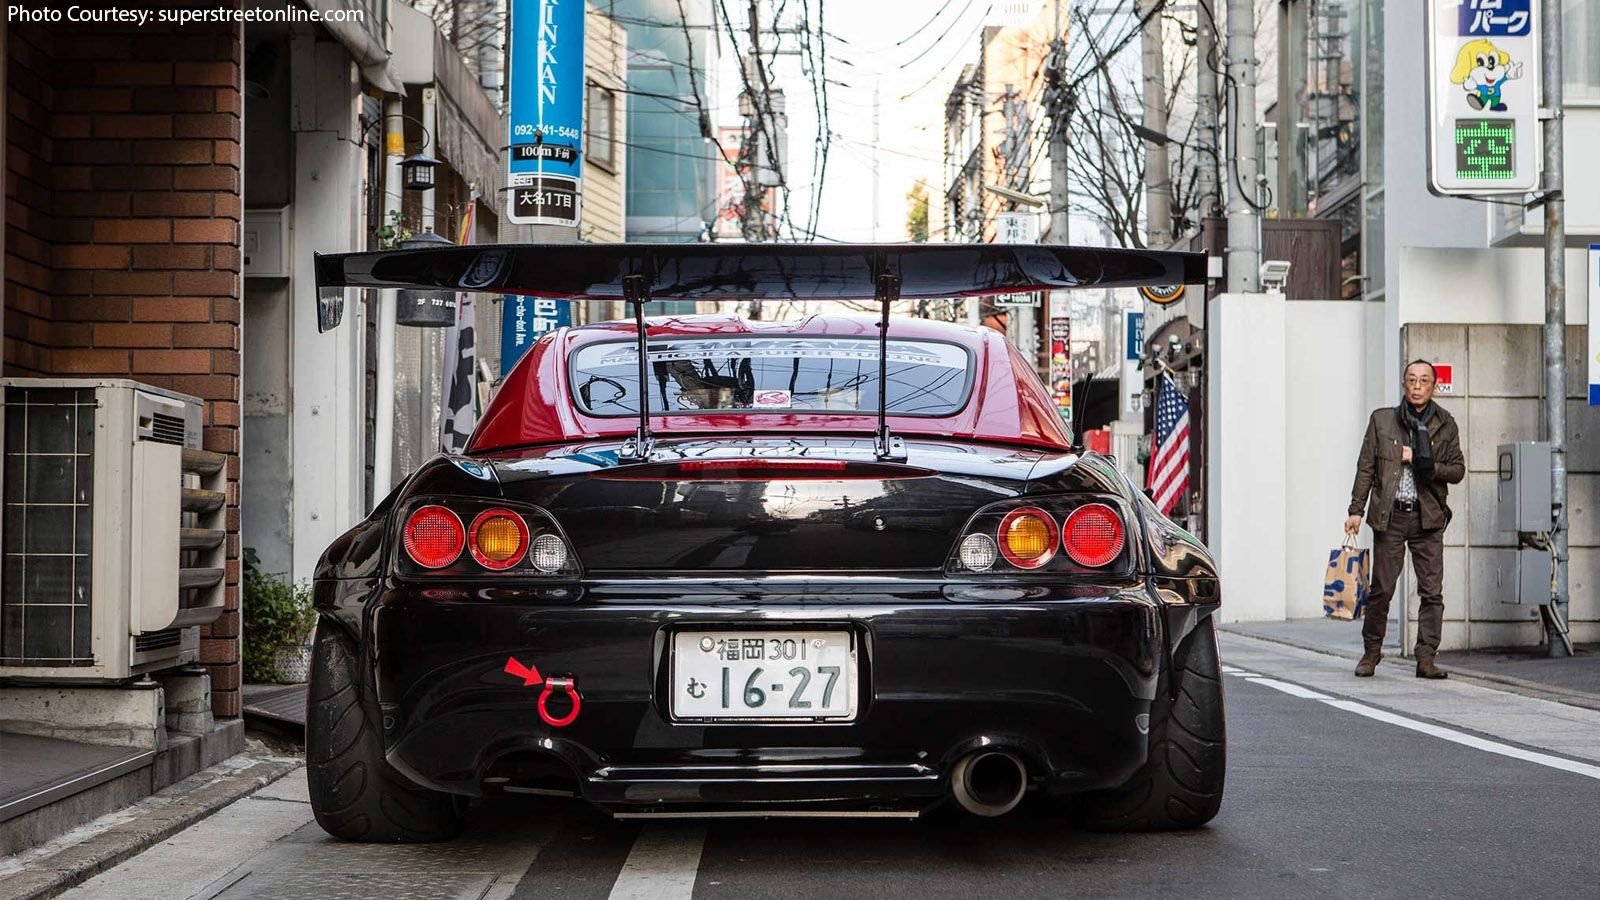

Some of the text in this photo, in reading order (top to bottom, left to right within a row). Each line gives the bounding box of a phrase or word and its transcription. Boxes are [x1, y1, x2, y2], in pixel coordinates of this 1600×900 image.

[1469, 10, 1529, 33] パーク
[542, 0, 559, 104] INKAN
[521, 146, 553, 157] 100m
[1456, 121, 1513, 179] 空
[520, 191, 572, 208] 大名1丁目
[657, 350, 741, 360] HONDA
[752, 350, 832, 358] SUPER
[717, 638, 806, 661] 福岡 301
[686, 666, 841, 709] む 16-27
